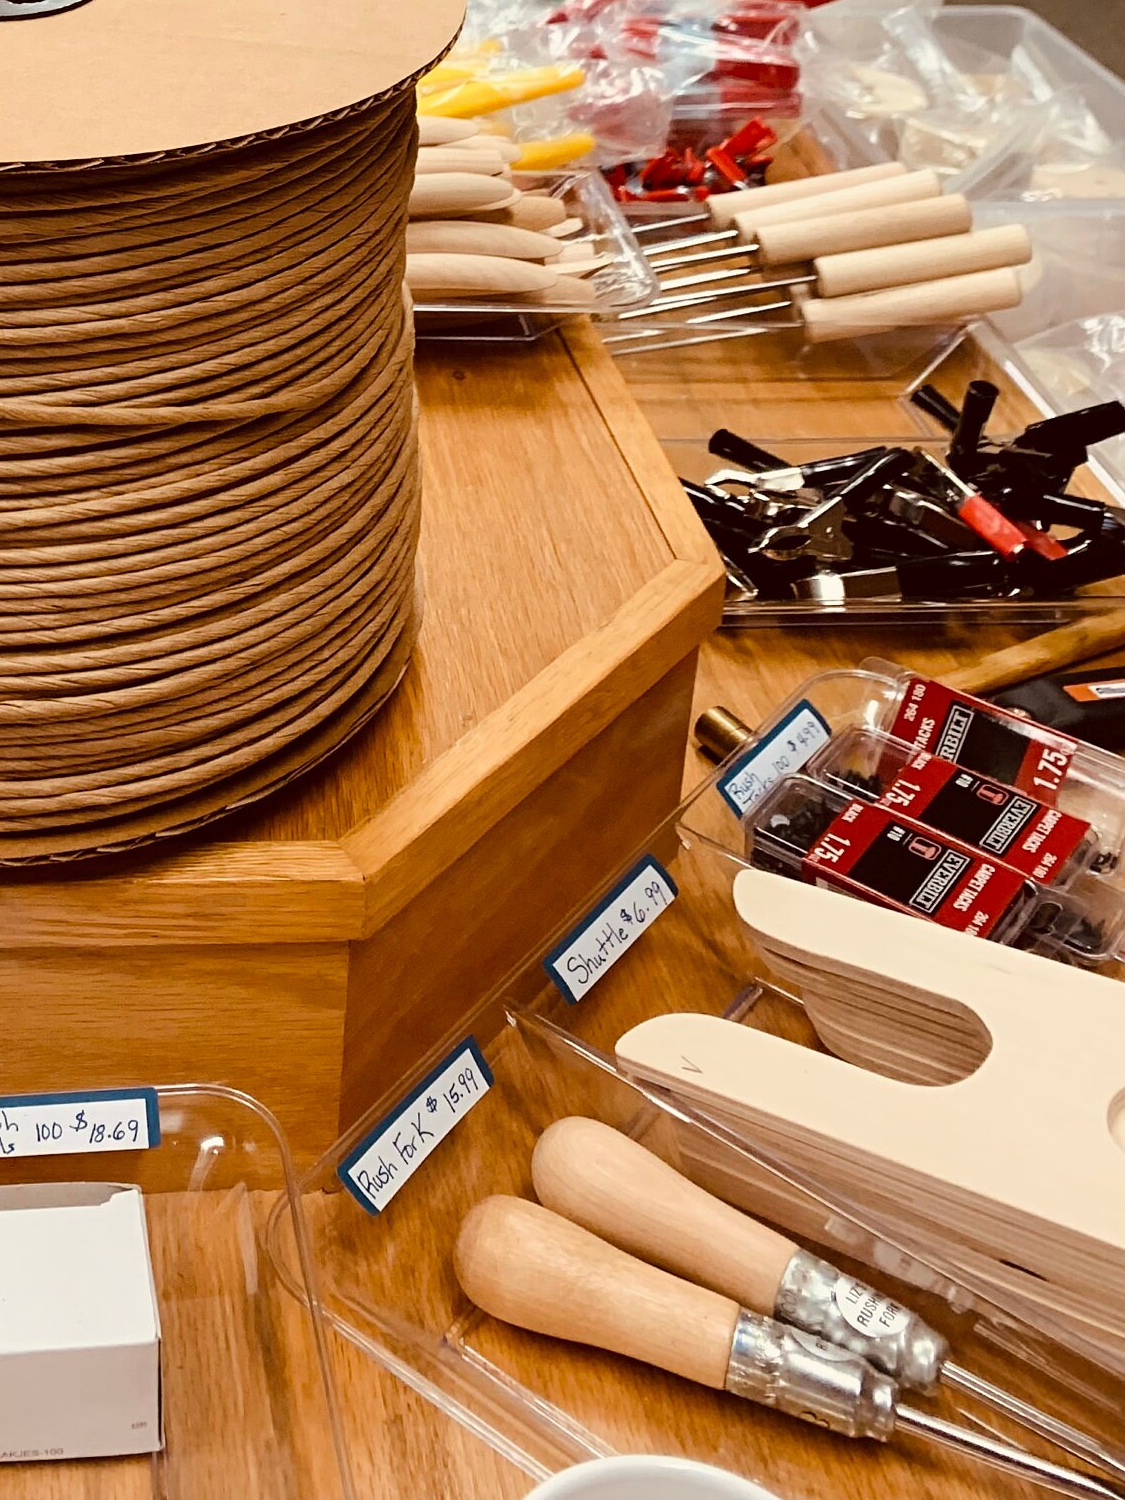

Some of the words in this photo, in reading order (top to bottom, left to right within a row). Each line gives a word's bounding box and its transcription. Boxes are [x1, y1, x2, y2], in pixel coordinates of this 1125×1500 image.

[939, 710, 970, 764] RBILT
[955, 773, 974, 788] #10
[1032, 748, 1069, 790] 1.75
[885, 779, 922, 807] 1.75
[886, 825, 906, 842] #10
[985, 799, 1032, 851] EVERBILT
[1036, 809, 1063, 836] CARPET
[813, 833, 851, 863] 1.75
[1022, 831, 1047, 853] TACKS
[916, 853, 965, 909] EVERBILT
[968, 863, 996, 892] CARPET
[953, 887, 978, 912] TACKS
[567, 922, 629, 985] Shuttle
[35, 1122, 63, 1142] 100
[356, 1155, 398, 1200] Rush
